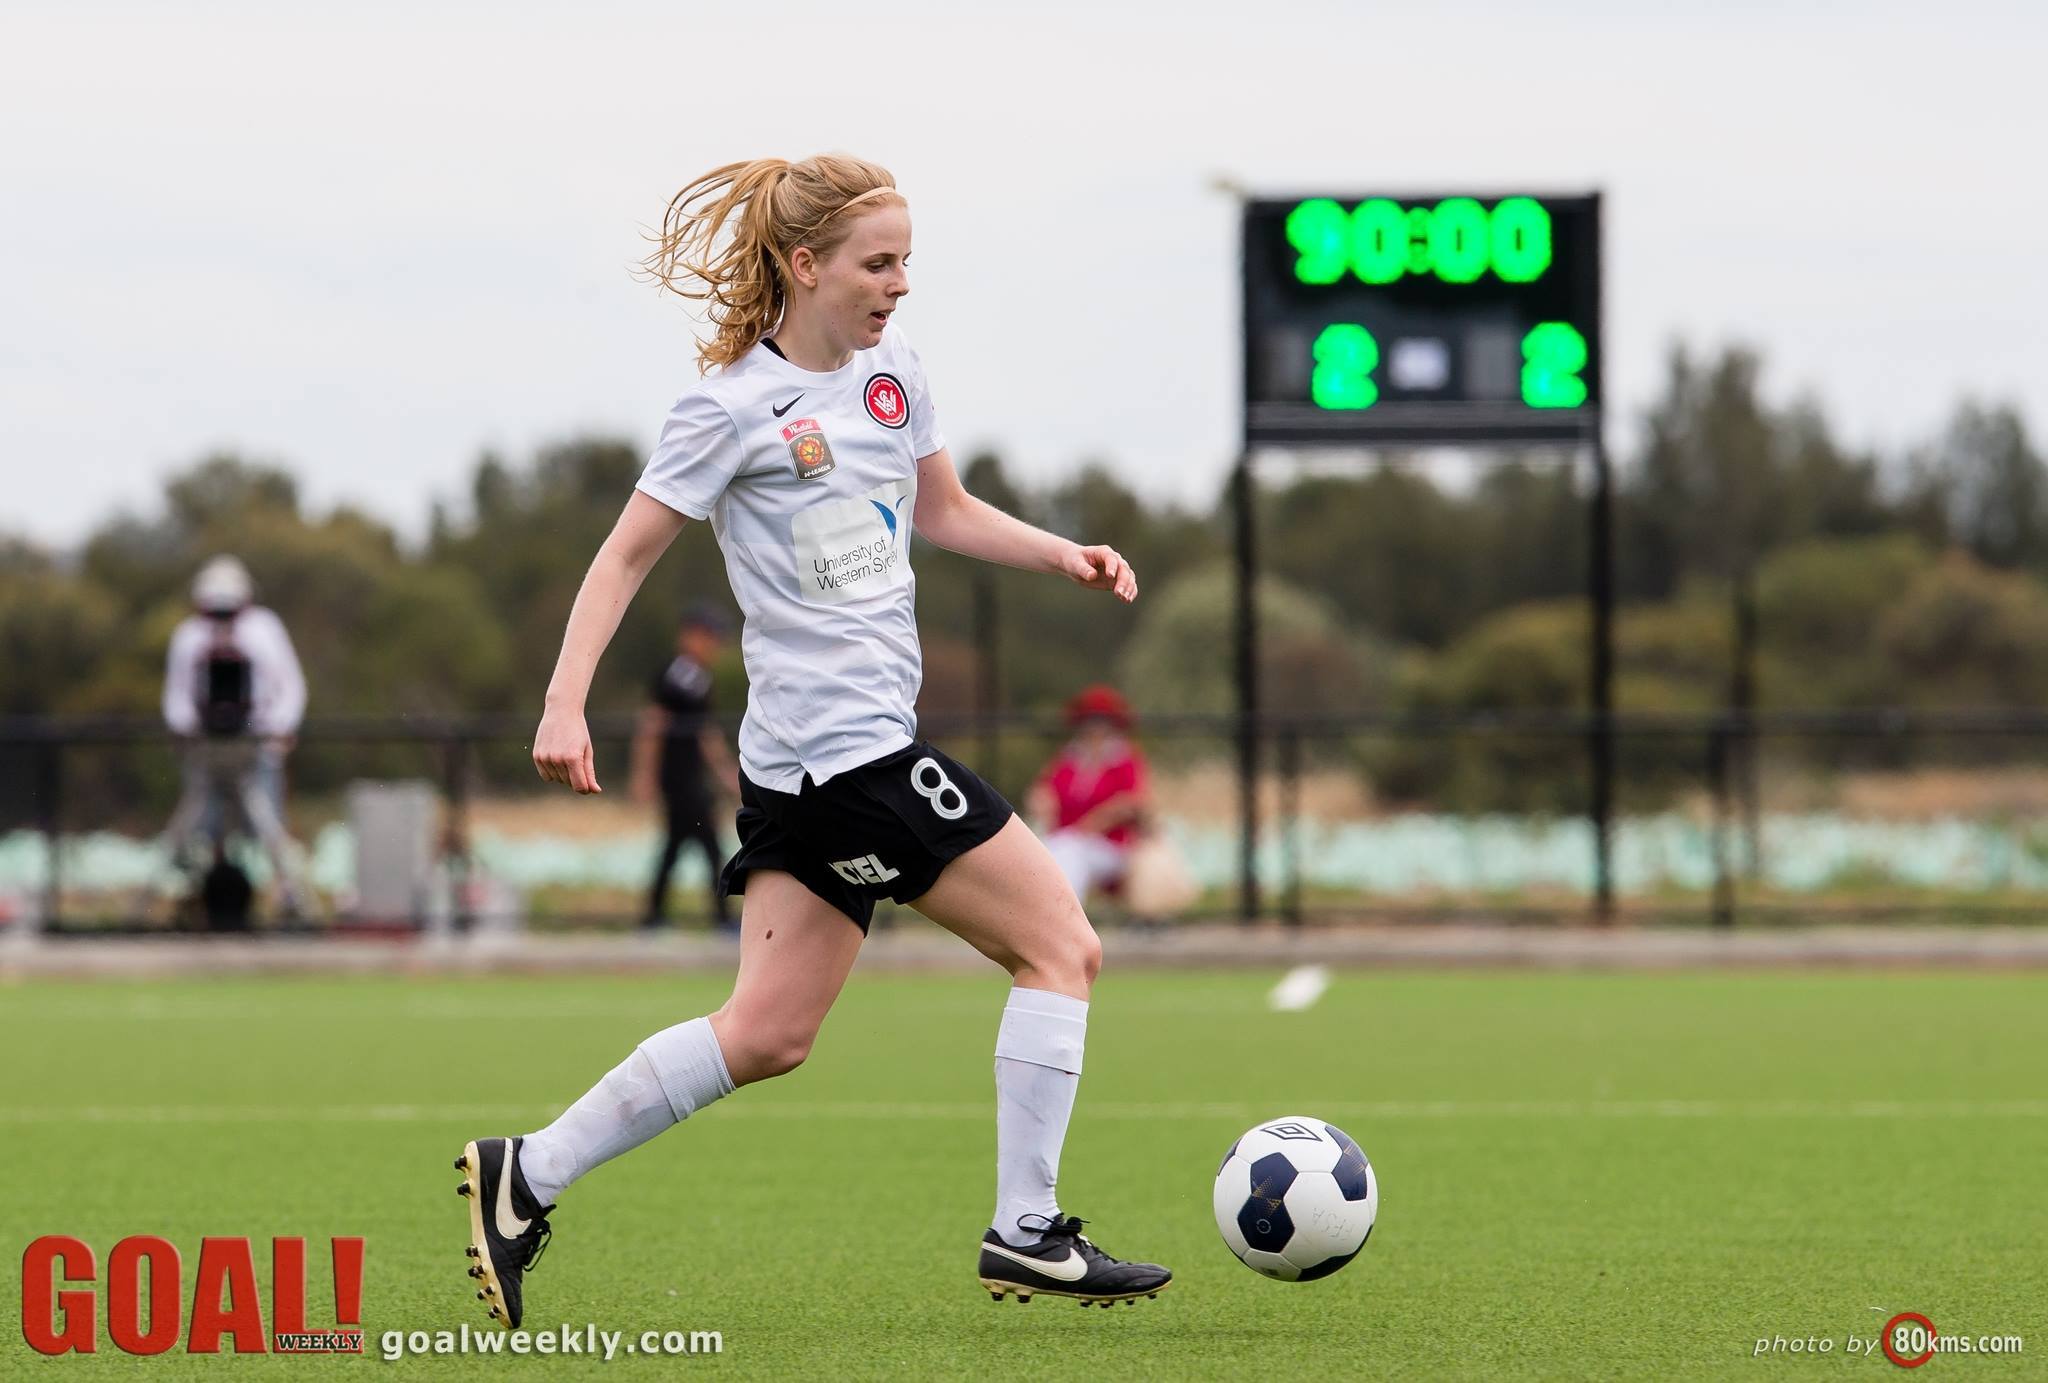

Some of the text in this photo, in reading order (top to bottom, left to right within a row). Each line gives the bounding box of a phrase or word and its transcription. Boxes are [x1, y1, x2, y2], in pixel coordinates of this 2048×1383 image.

[1286, 195, 1551, 284] 90:00
[1312, 322, 1587, 410] 2 2
[813, 535, 886, 574] University of
[816, 564, 871, 590] Western
[910, 757, 968, 820] 8
